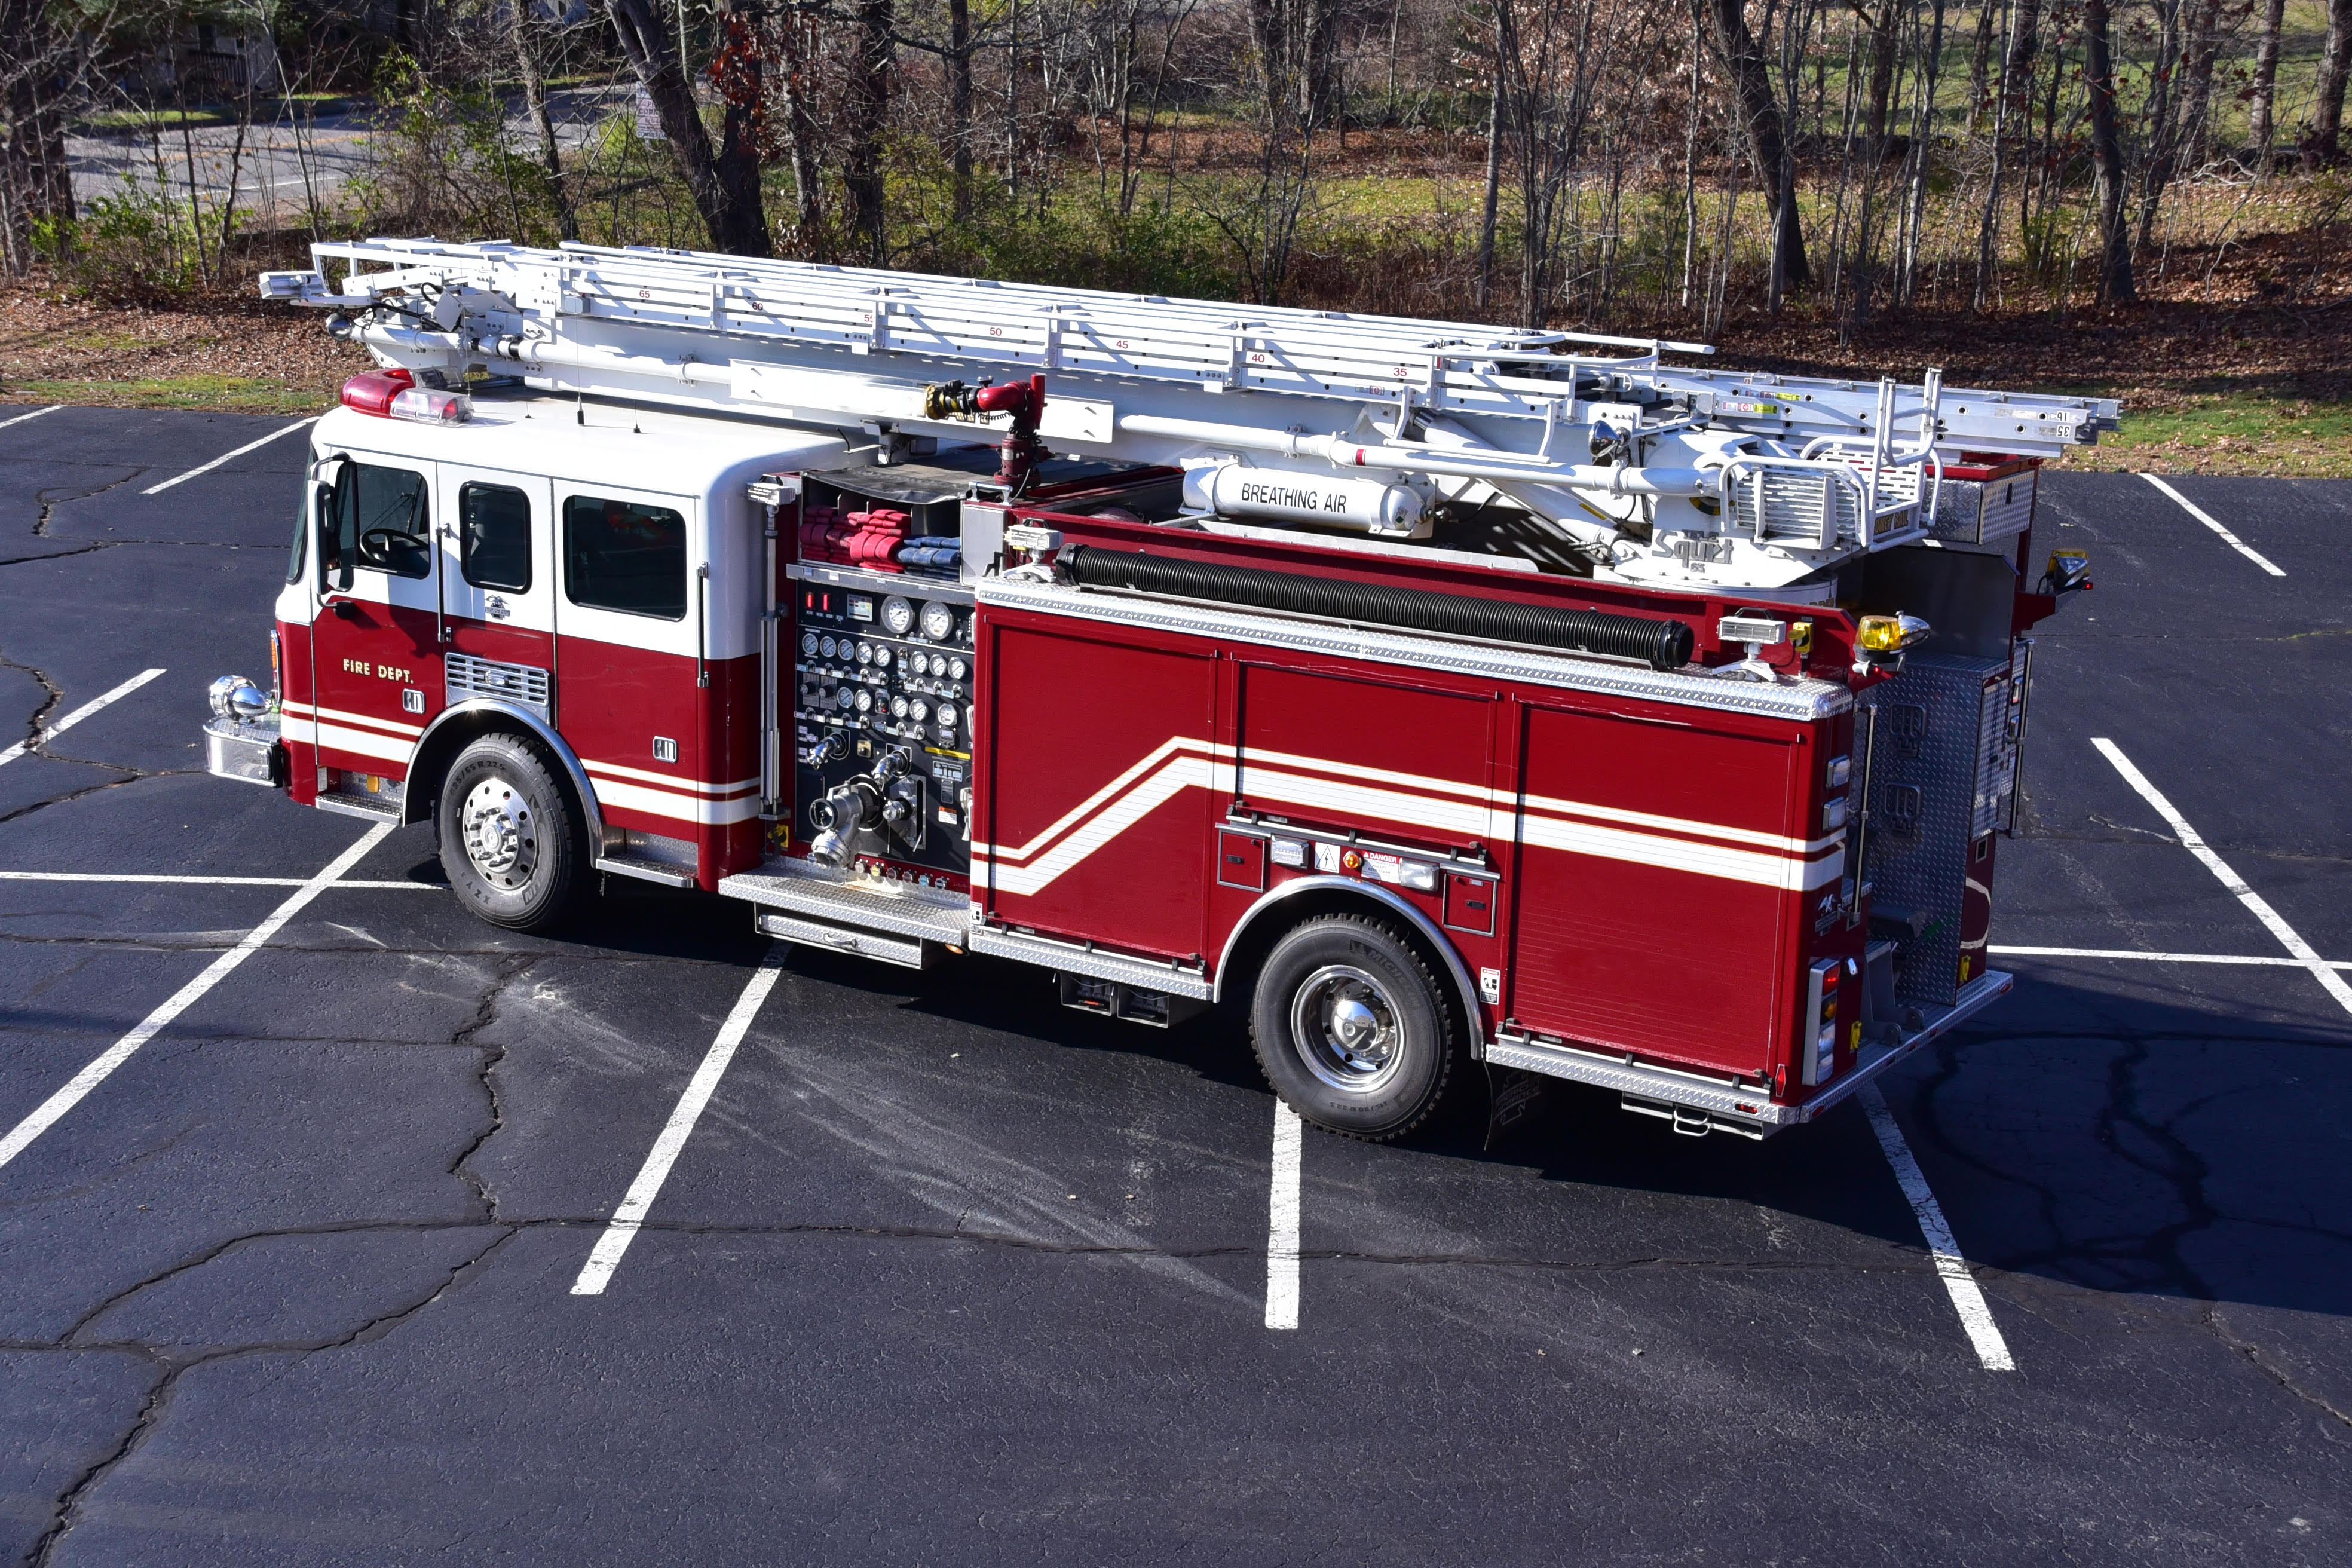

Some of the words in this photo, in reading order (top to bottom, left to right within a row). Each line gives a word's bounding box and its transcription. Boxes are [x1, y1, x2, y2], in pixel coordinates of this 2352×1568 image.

[639, 290, 650, 298] 65
[752, 302, 764, 311] 60
[990, 327, 1002, 336] 50
[1116, 340, 1129, 349] 45
[1252, 354, 1265, 363] 40
[1393, 368, 1407, 377] 35
[1241, 483, 1318, 510] BREATHING
[1324, 494, 1347, 513] AIR
[343, 658, 370, 675] FIRE
[378, 664, 414, 684] DEPT.
[1370, 852, 1397, 863] DANGER
